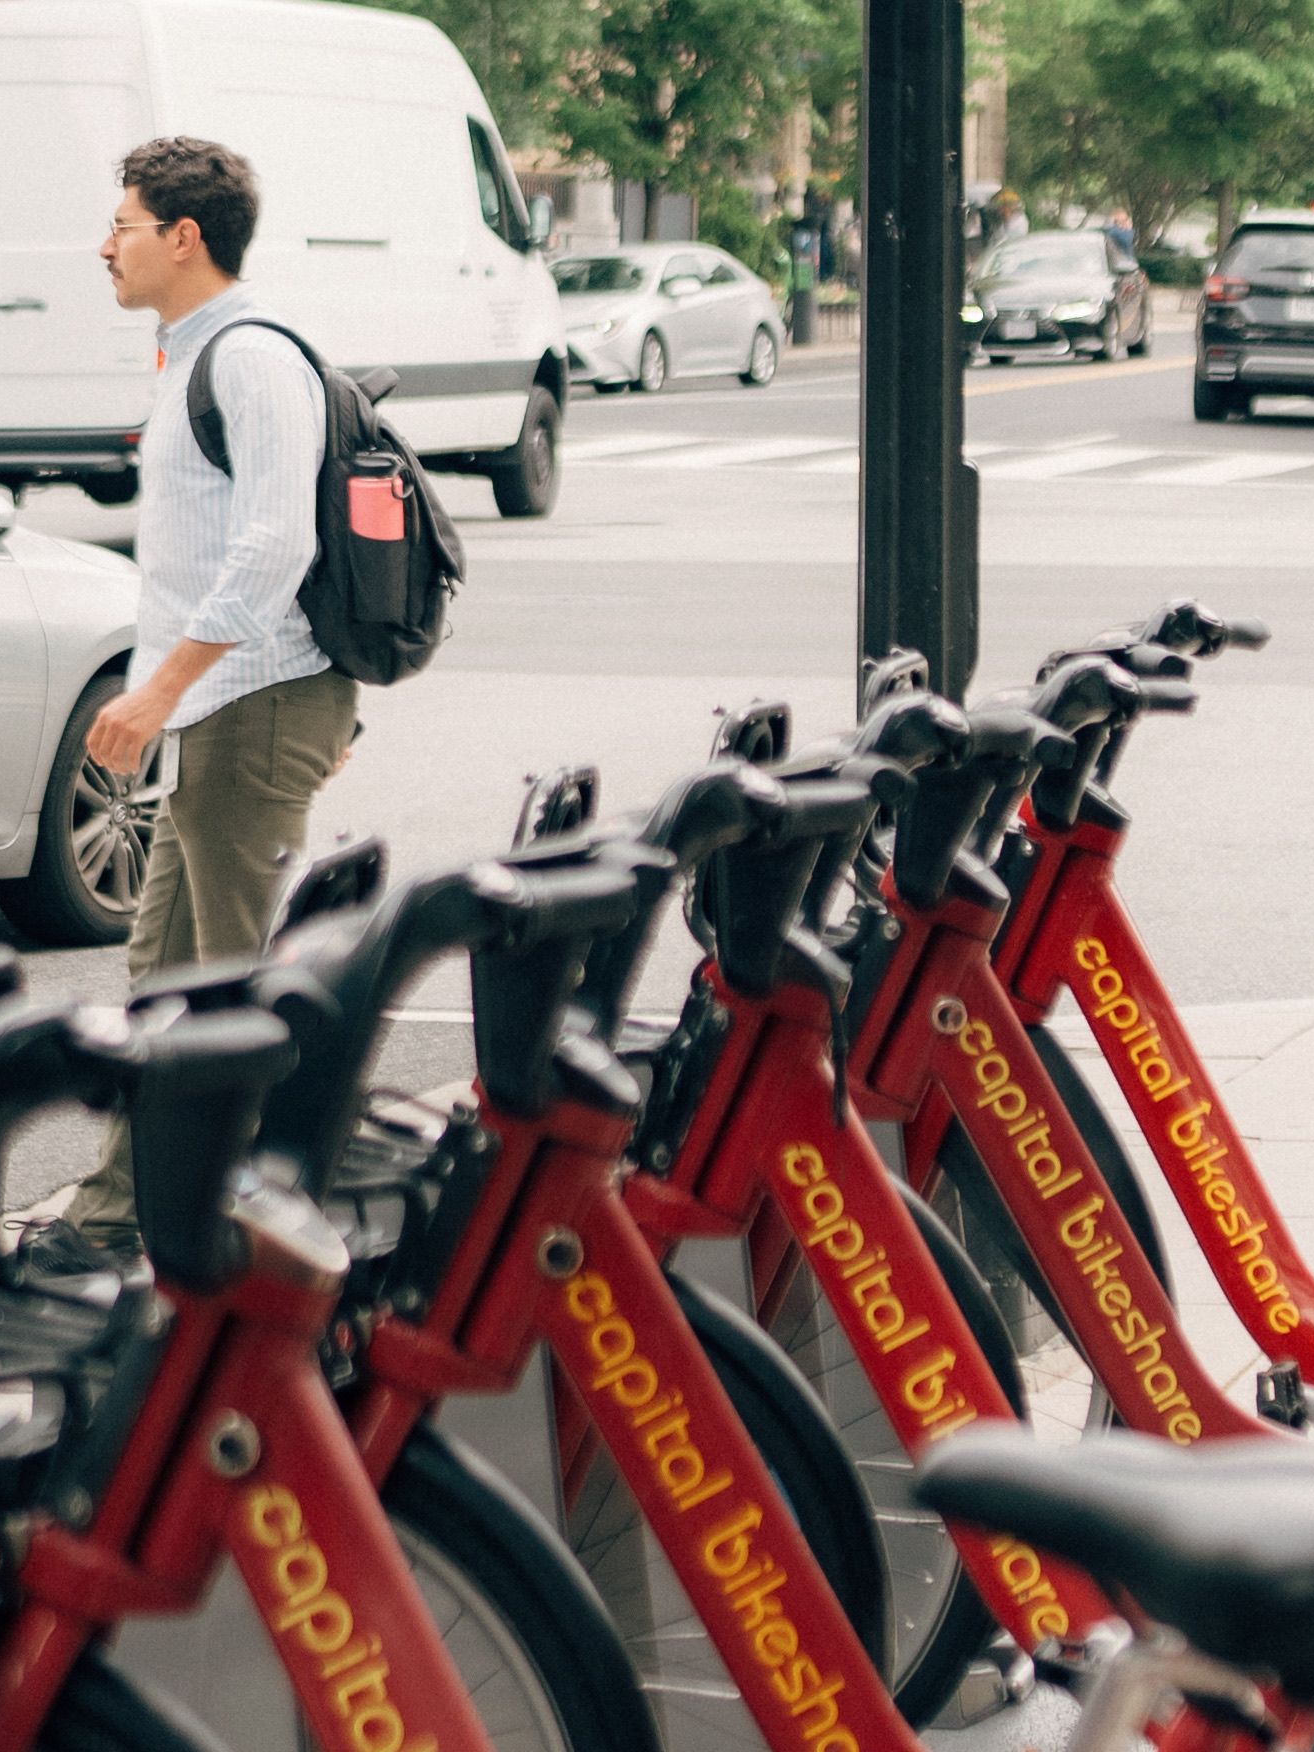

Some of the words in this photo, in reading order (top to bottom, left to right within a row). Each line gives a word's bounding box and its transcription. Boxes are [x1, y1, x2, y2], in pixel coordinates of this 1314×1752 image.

[782, 1144, 930, 1353] capital
[958, 1020, 1082, 1198] capital
[1058, 1194, 1202, 1445] bikeshare
[1073, 936, 1191, 1102] capital
[1166, 1097, 1301, 1335] bikeshare
[567, 1278, 732, 1510] capital
